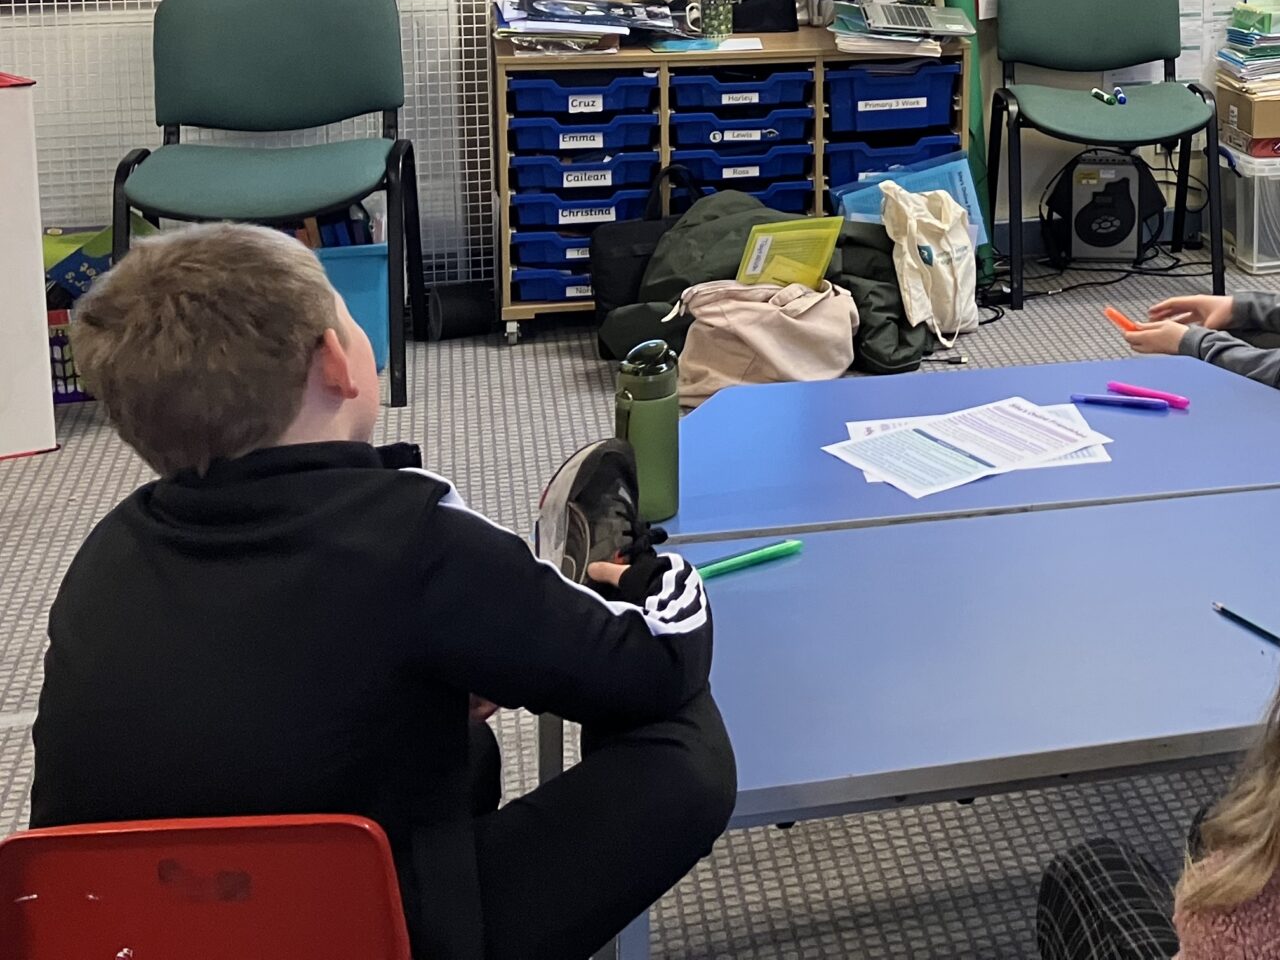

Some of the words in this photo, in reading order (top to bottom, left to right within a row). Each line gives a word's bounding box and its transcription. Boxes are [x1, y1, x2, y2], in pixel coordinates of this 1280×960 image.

[570, 98, 597, 109] Cruz
[727, 94, 753, 104] Harley
[561, 133, 596, 143] Emma
[731, 131, 753, 140] Lewis
[565, 172, 607, 183] Cailean
[560, 207, 612, 219] Christina
